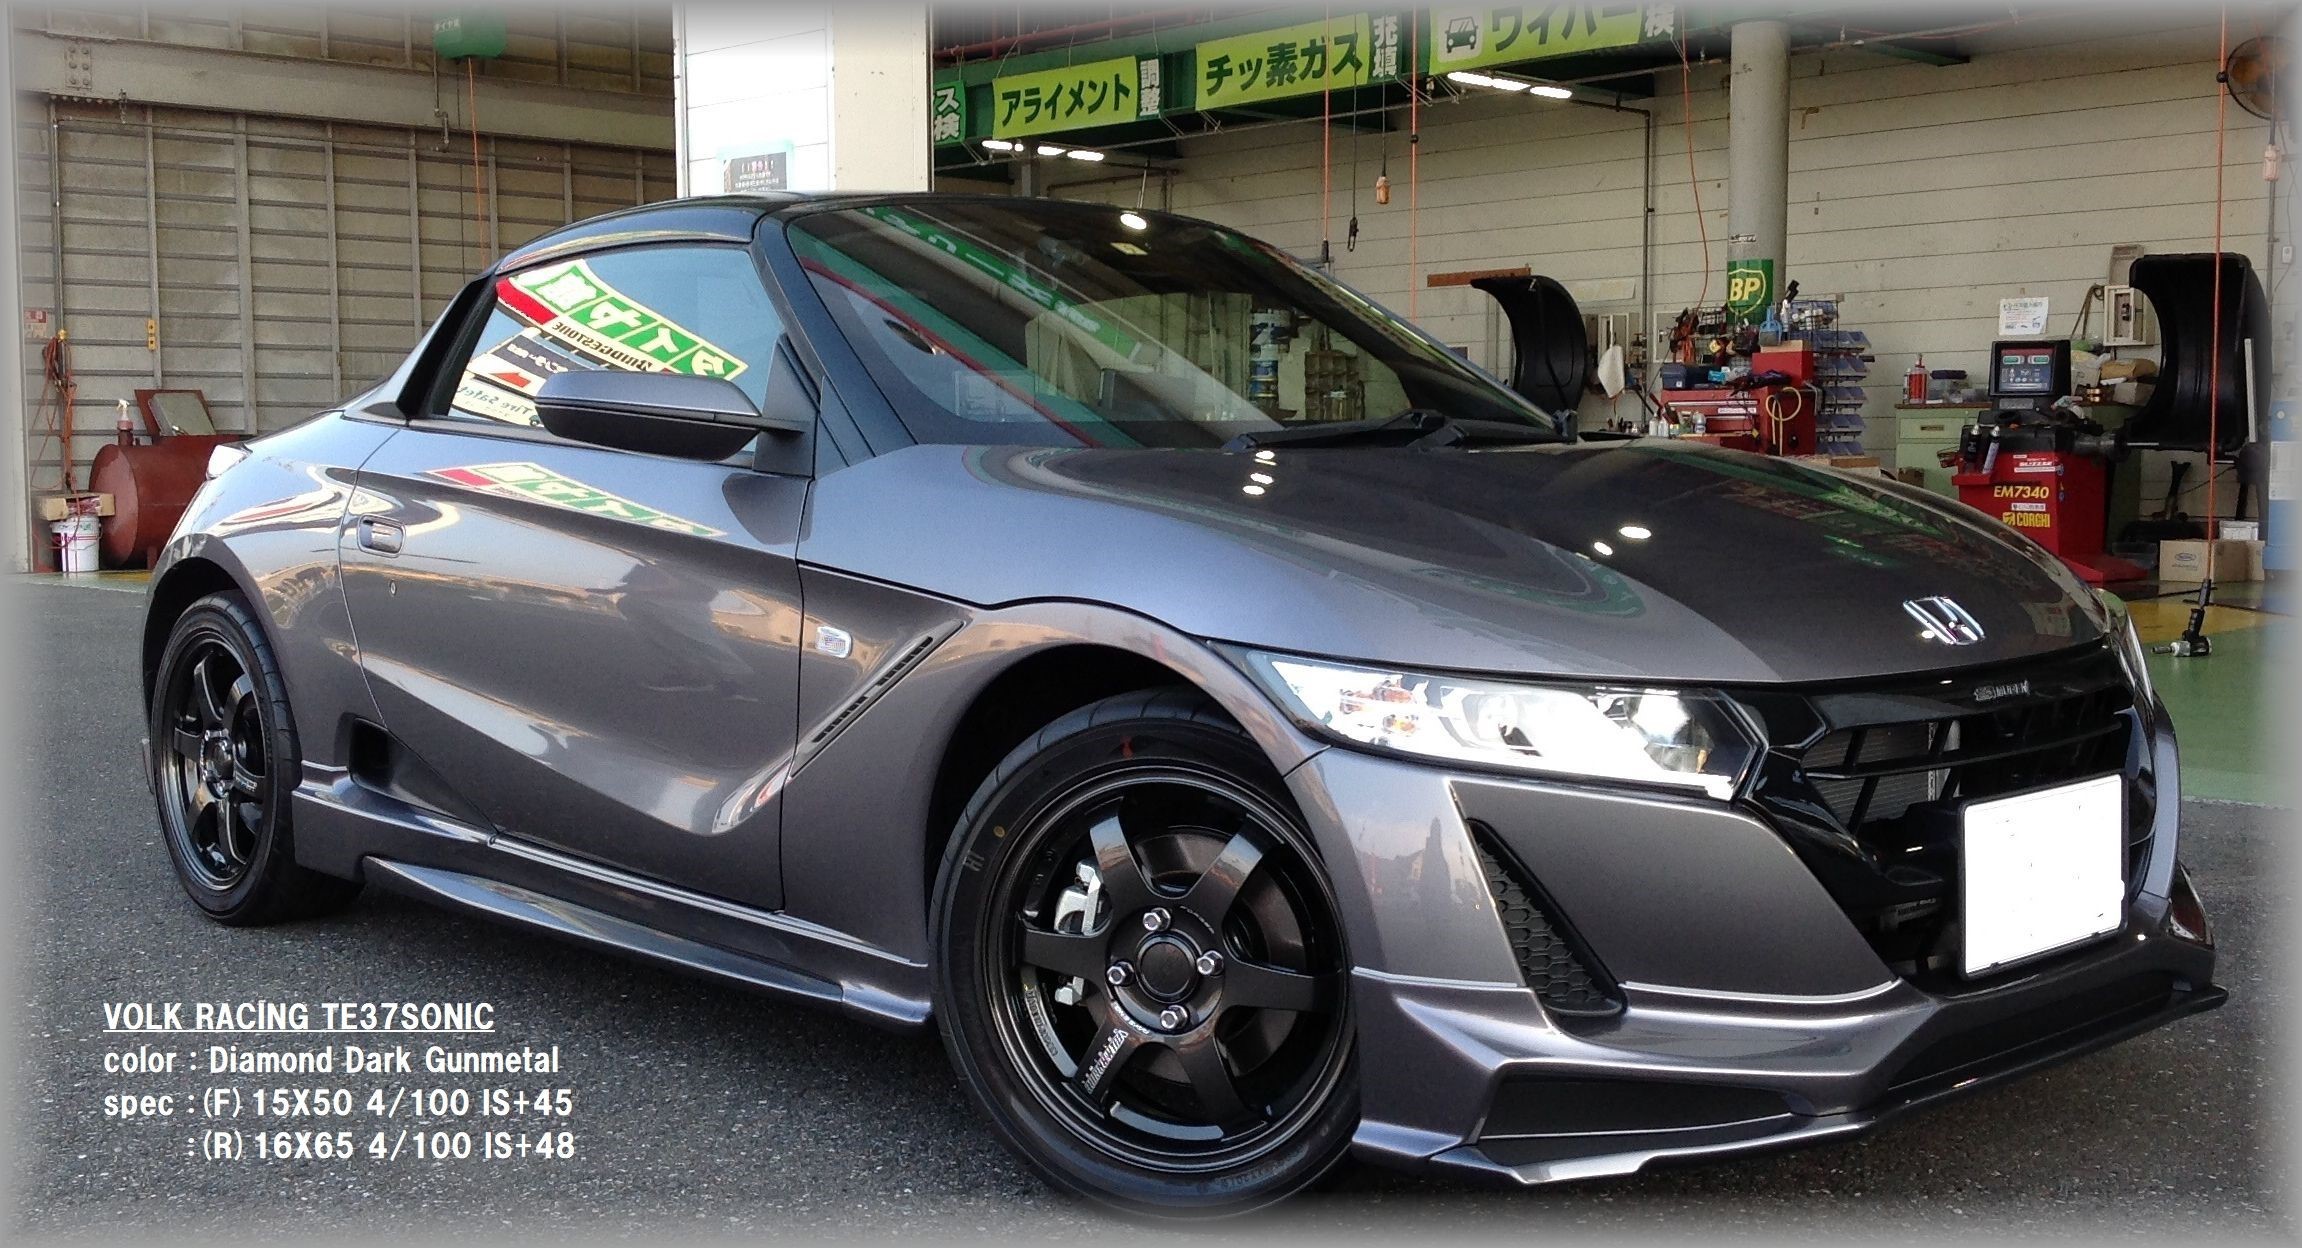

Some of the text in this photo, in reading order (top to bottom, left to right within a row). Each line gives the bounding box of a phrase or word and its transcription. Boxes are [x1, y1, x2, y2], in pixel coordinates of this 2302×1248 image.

[1205, 32, 1363, 96] チッ素ガス
[1372, 16, 1398, 78] 充填
[1001, 73, 1131, 127] アライメント
[1140, 58, 1160, 116] 調整
[1729, 277, 1761, 301] BP
[1993, 485, 2050, 499] EM7340
[2016, 512, 2051, 528] CORGHI
